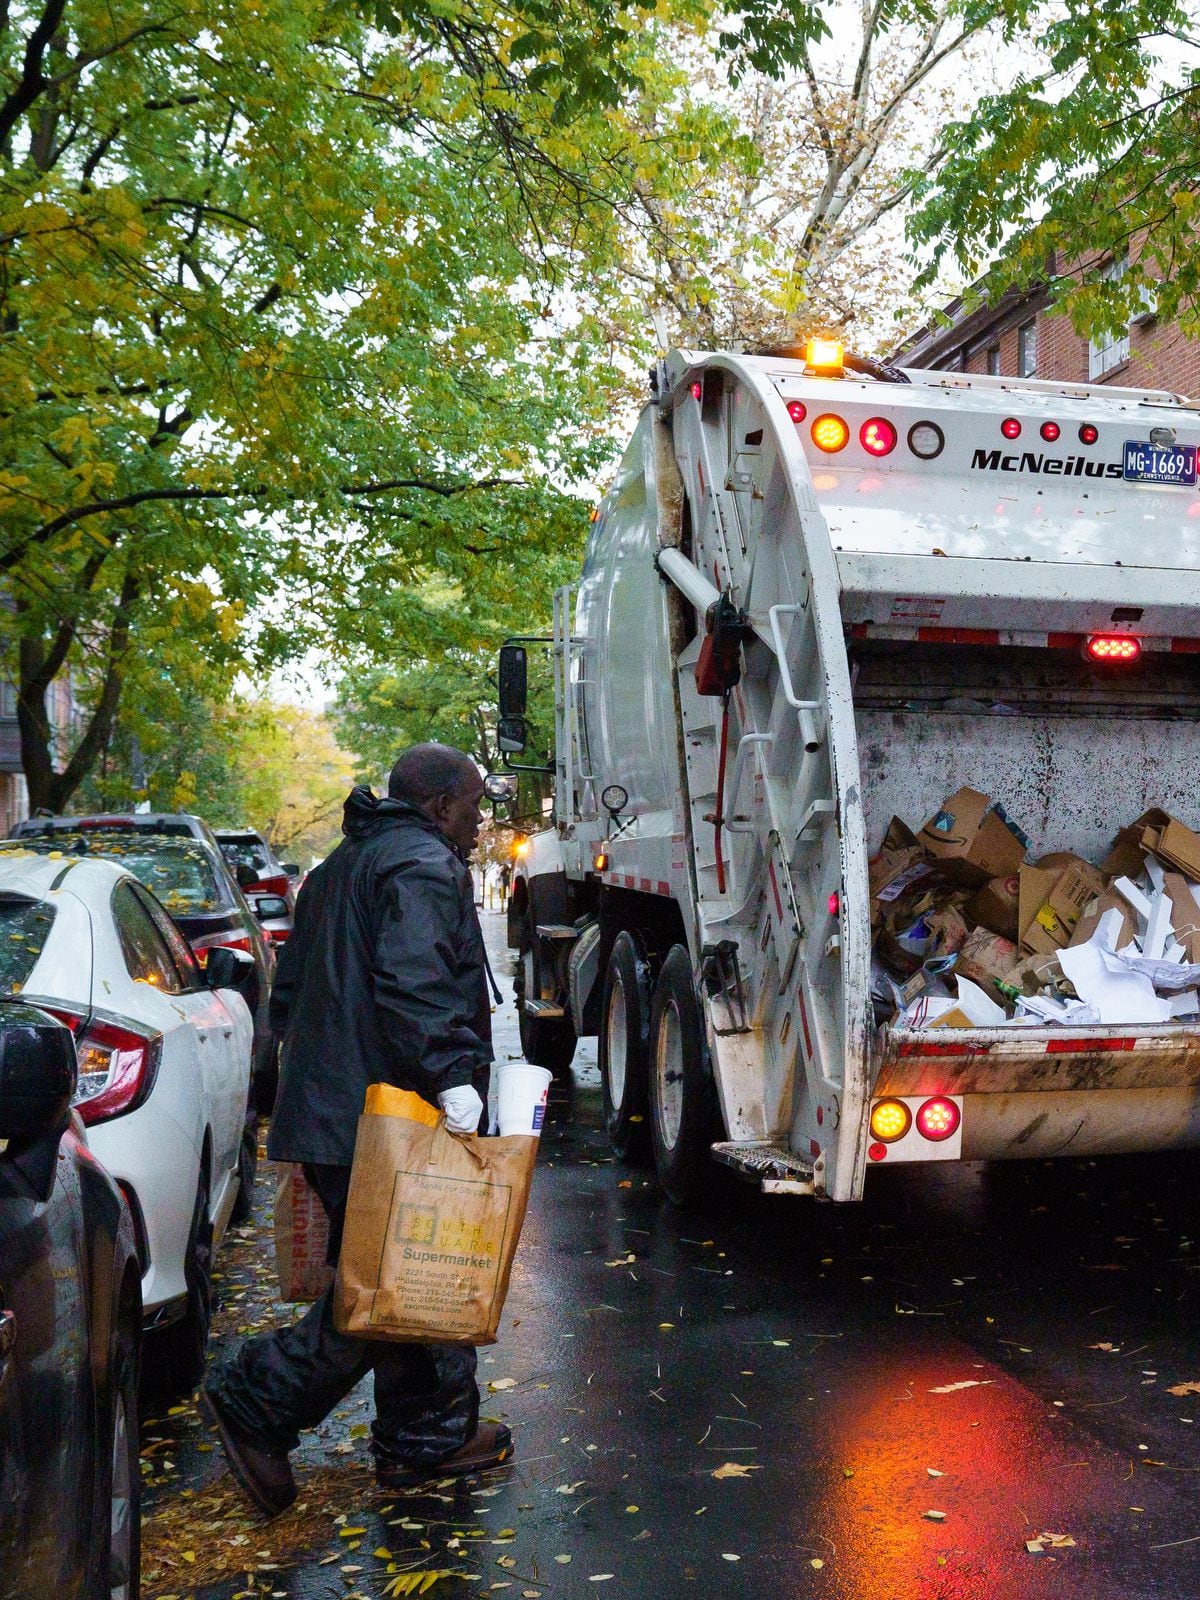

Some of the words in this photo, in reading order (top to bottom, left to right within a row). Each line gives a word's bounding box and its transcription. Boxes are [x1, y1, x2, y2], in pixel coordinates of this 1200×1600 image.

[971, 449, 1123, 479] McNeilus
[1127, 452, 1193, 475] MG-1669J
[402, 1247, 492, 1269] Supermarket
[425, 1271, 448, 1279] South
